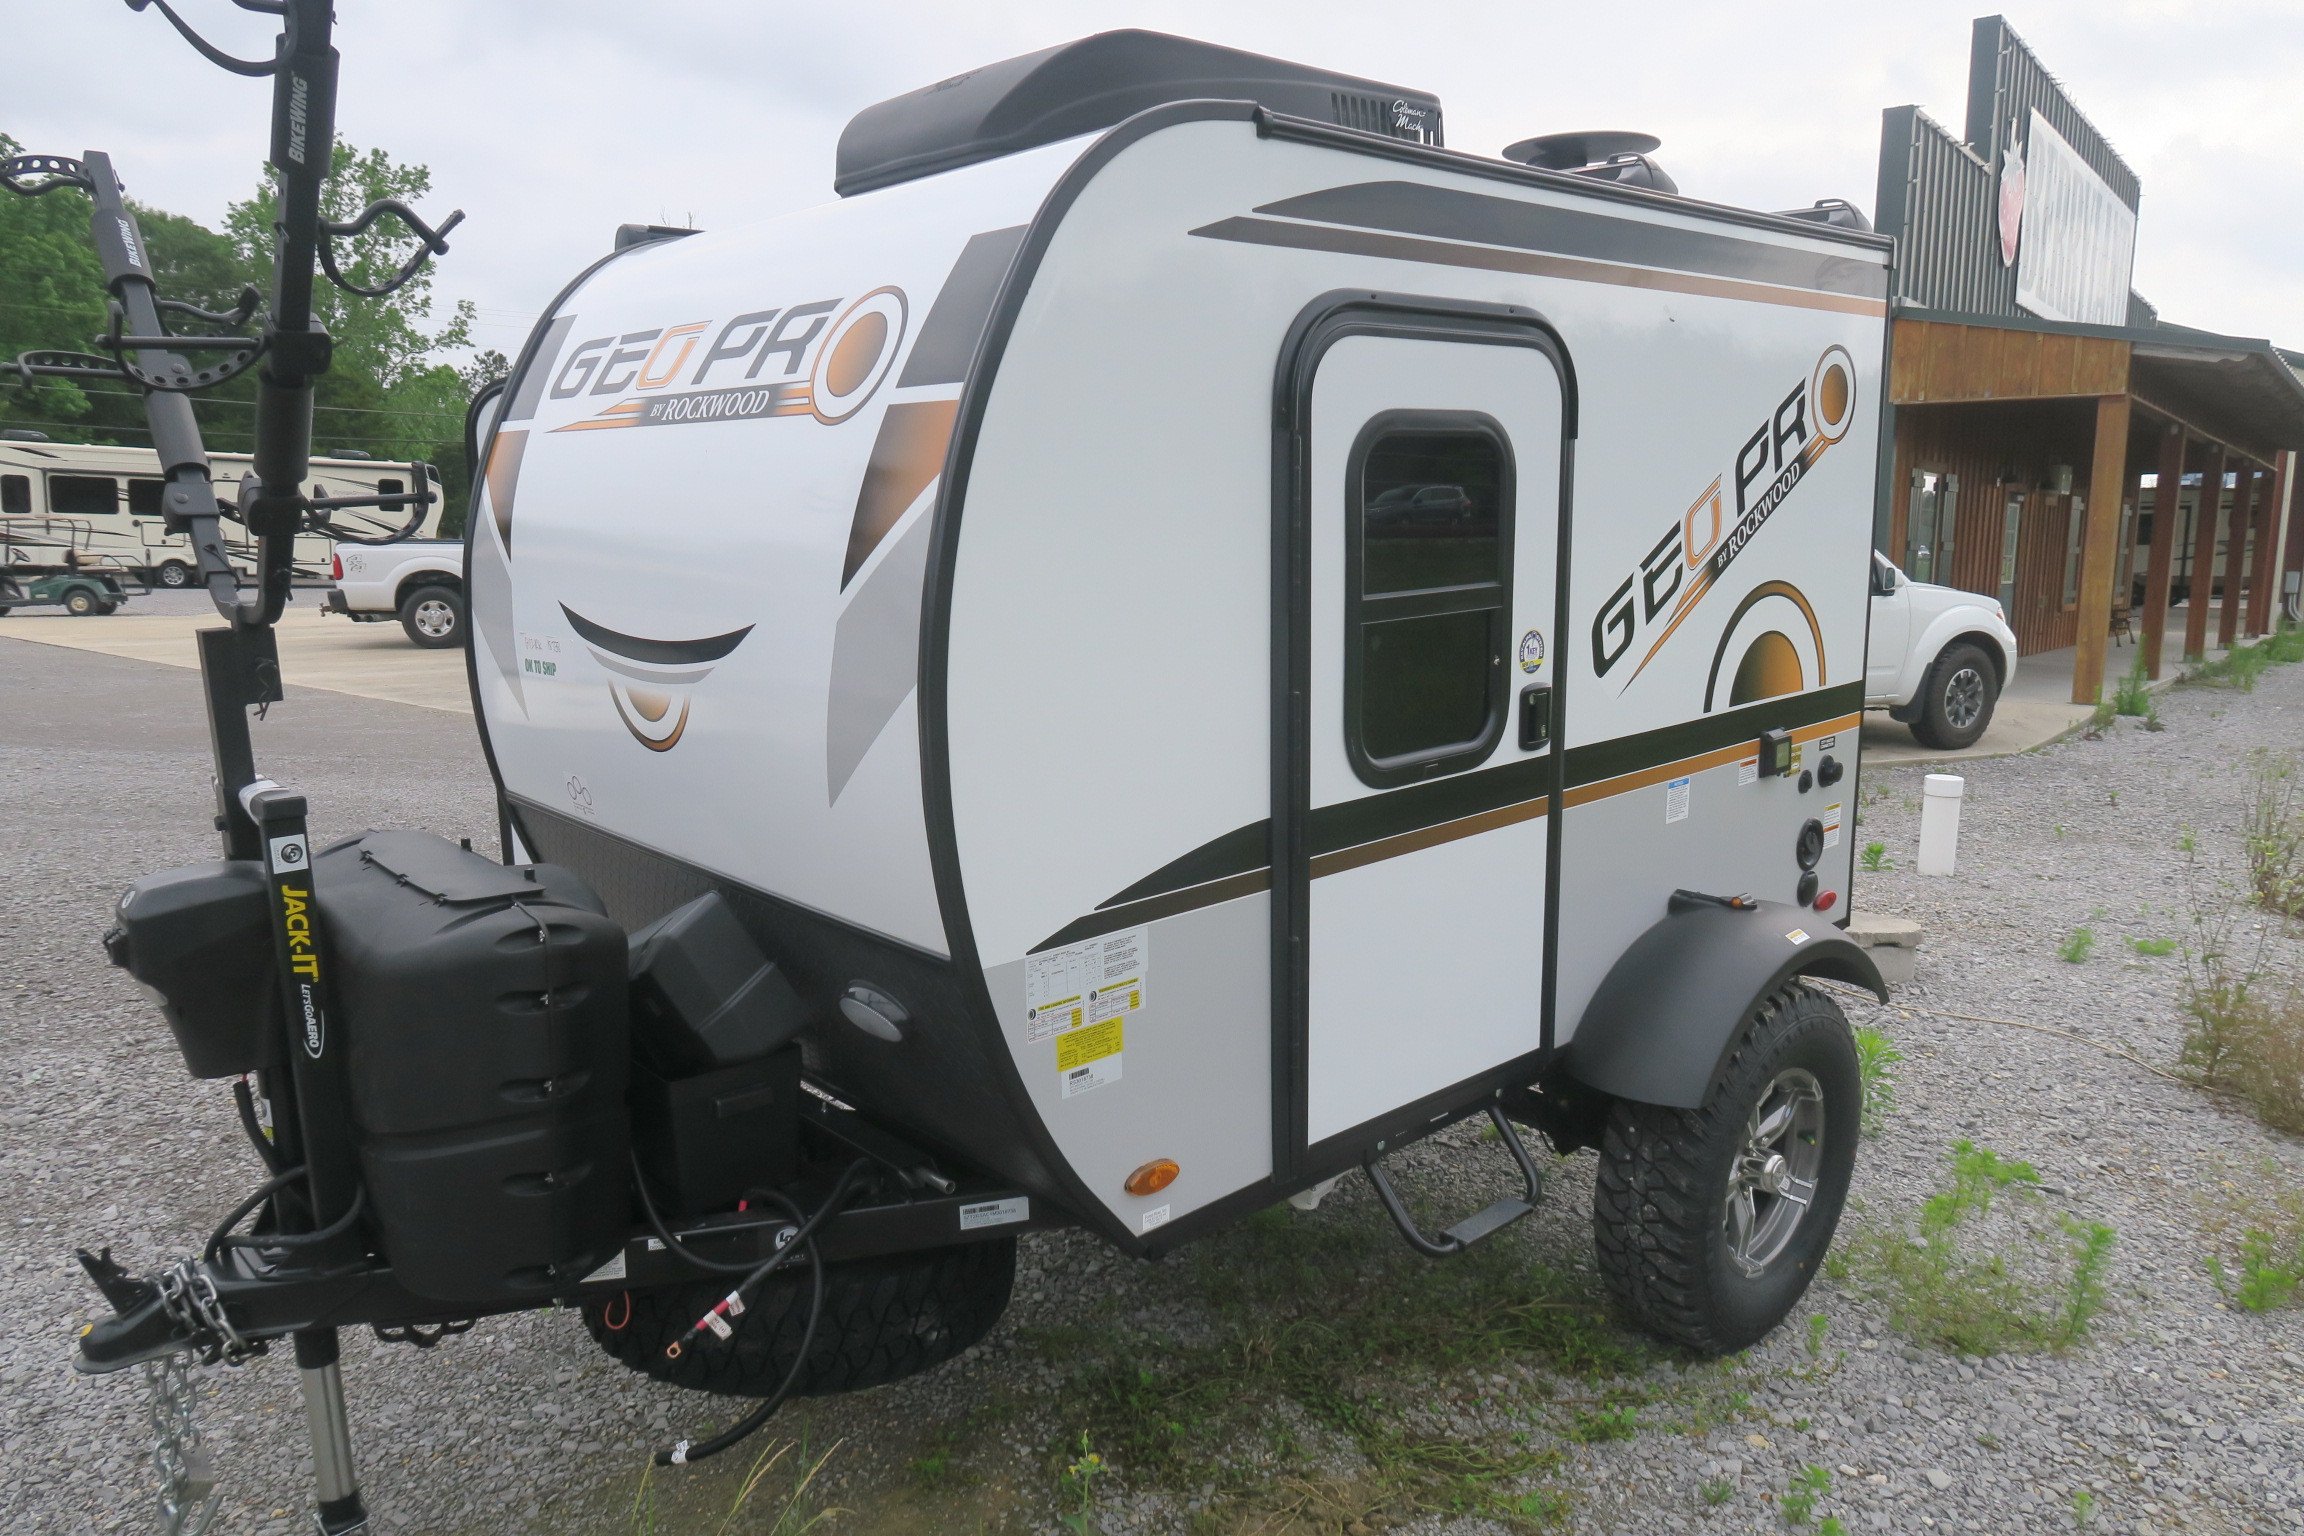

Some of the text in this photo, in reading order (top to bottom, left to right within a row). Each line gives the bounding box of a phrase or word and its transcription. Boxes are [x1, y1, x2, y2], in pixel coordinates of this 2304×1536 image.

[288, 76, 308, 165] BIKEWING
[117, 219, 142, 268] BIKEWING
[549, 284, 909, 426] GEO PRO
[650, 389, 771, 421] BY ROCKWOOD
[1591, 343, 1857, 679] GEO PRO
[1717, 462, 1800, 568] BY ROCKWOOD
[524, 657, 534, 673] OK
[533, 659, 541, 675] TO
[281, 885, 320, 978] JACK-IT
